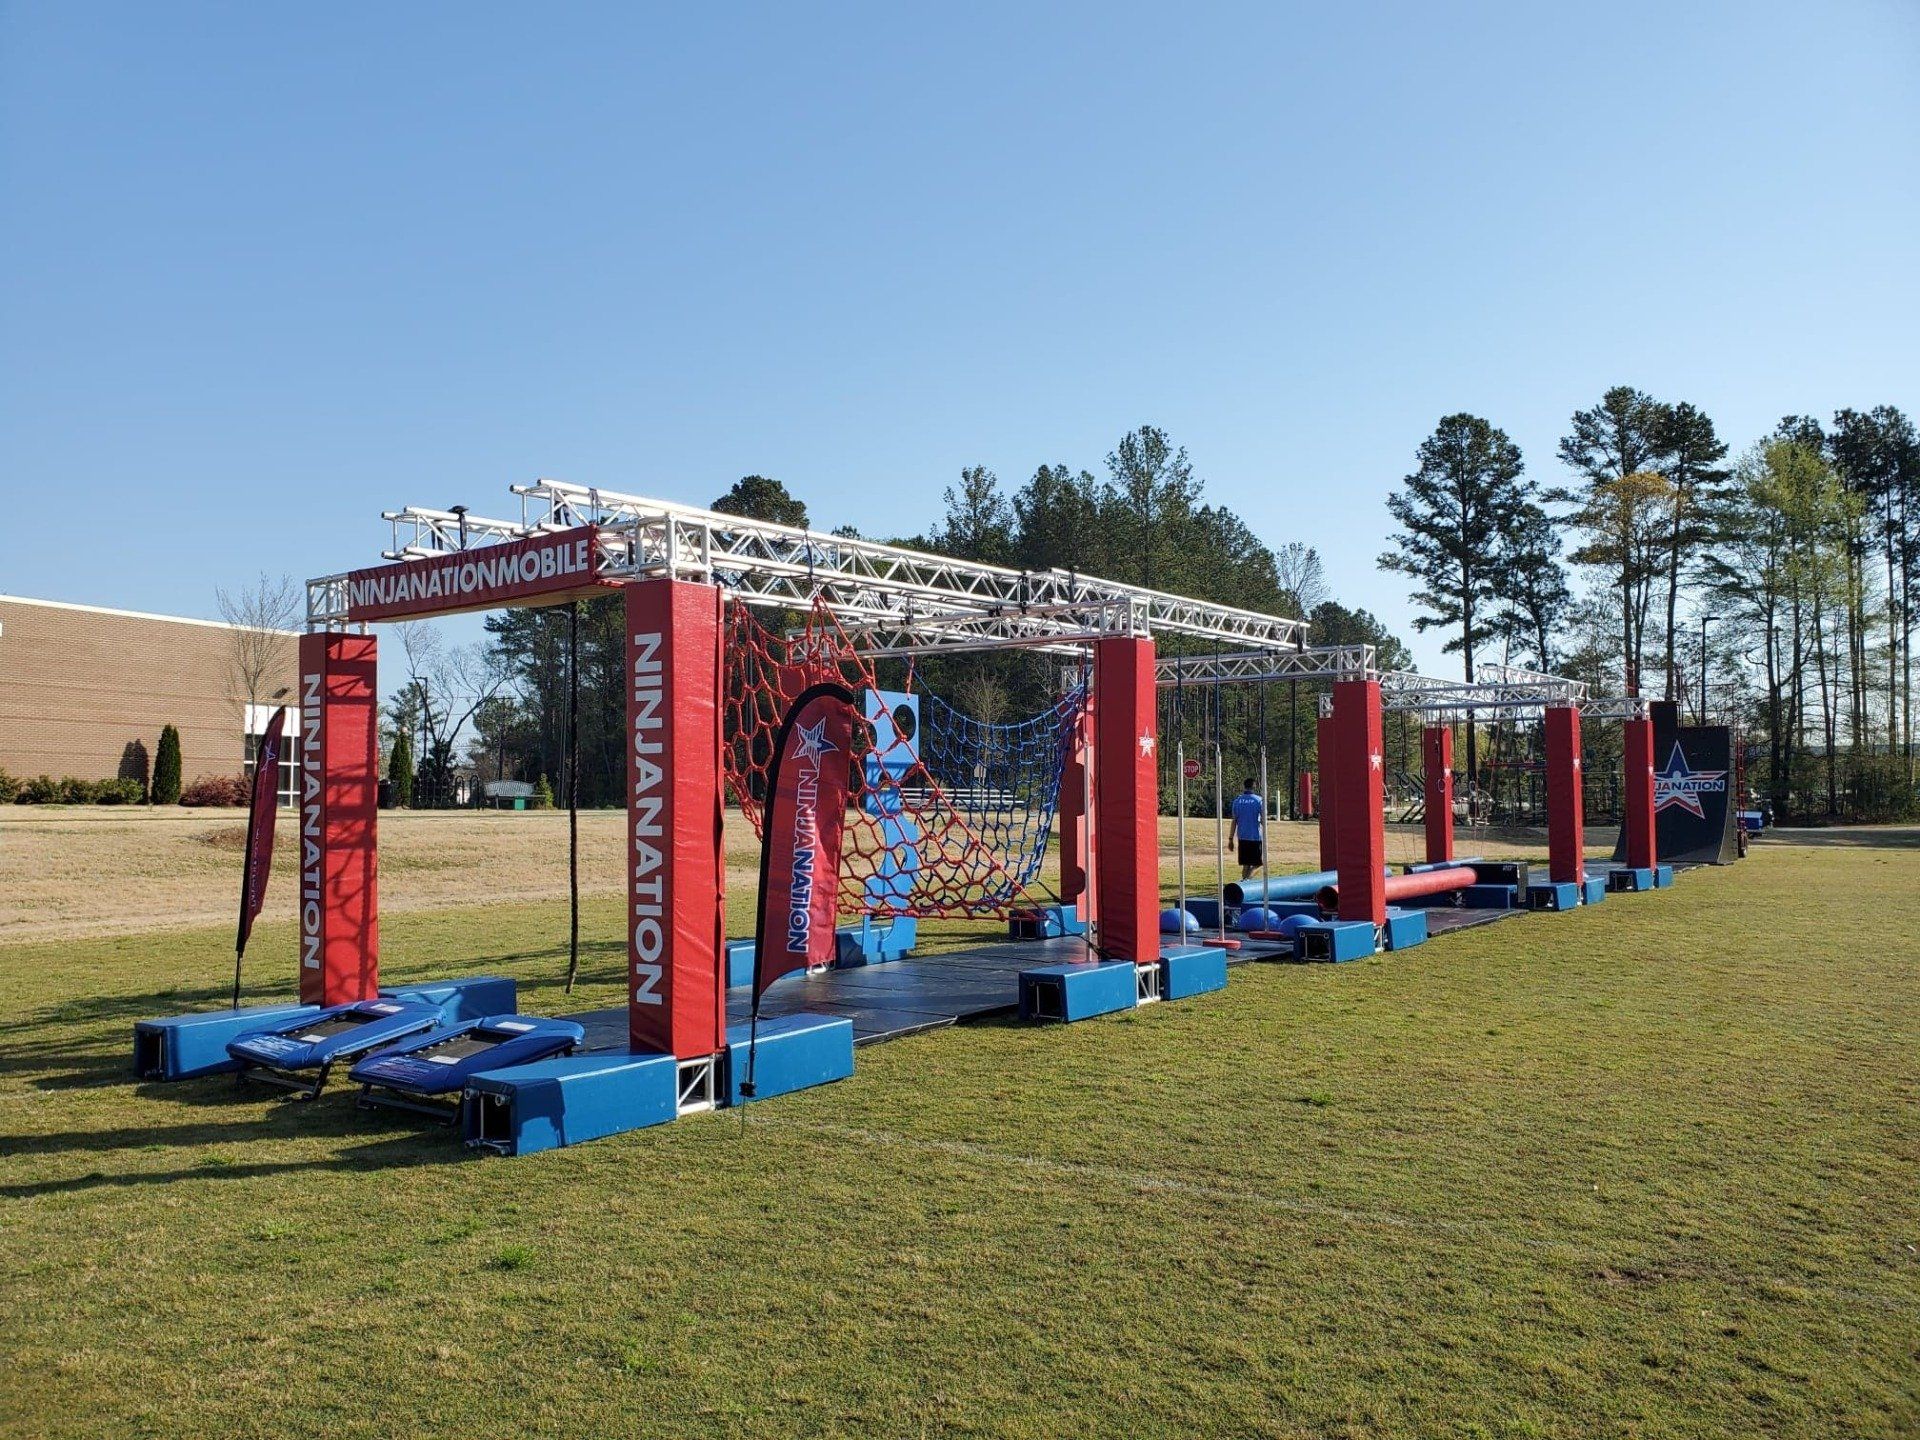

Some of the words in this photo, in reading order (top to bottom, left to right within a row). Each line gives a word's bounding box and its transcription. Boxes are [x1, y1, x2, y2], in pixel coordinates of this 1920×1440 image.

[350, 539, 588, 607] NINJANATIONMOBILE
[304, 674, 321, 969] NINJANATION
[634, 632, 663, 1005] NINJANATION
[1184, 765, 1199, 773] STOP
[1655, 780, 1725, 792] JANATION
[787, 768, 818, 953] NINJANATION
